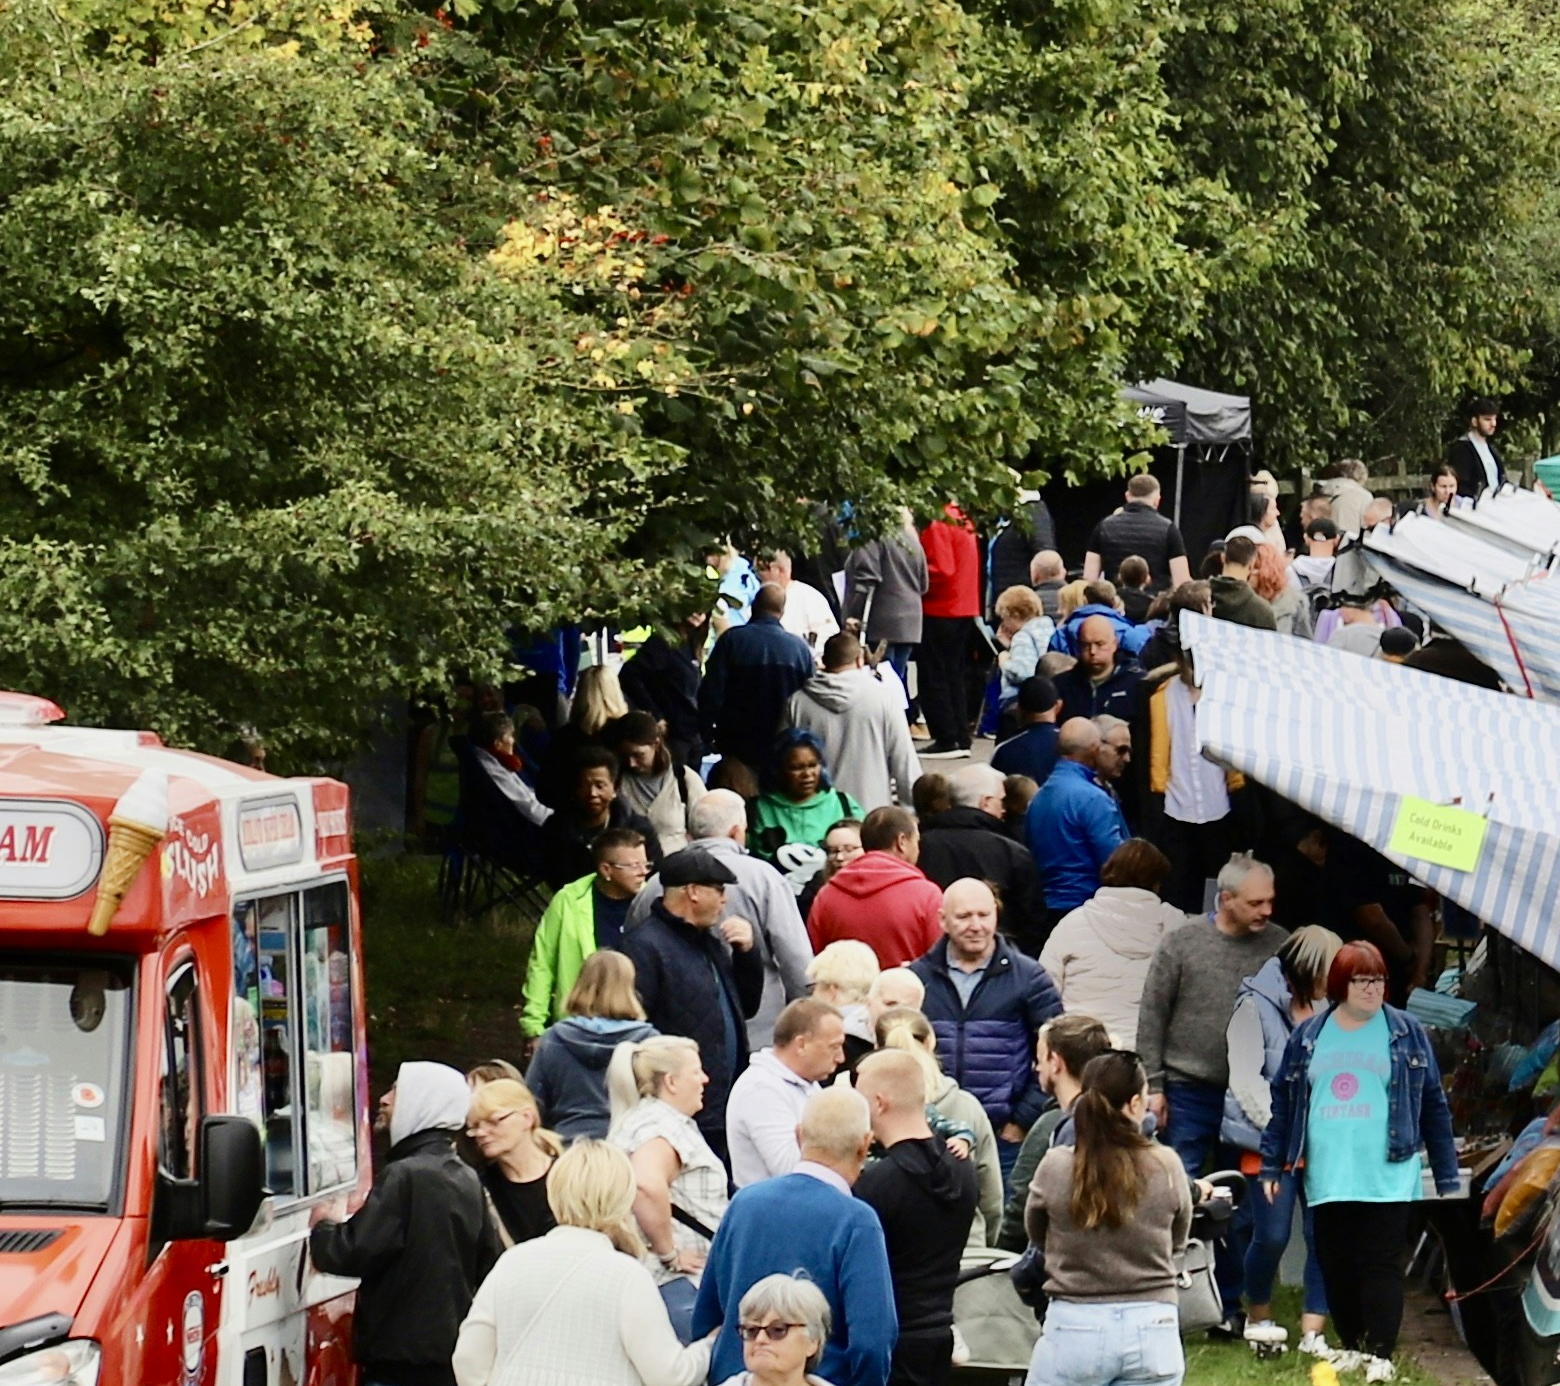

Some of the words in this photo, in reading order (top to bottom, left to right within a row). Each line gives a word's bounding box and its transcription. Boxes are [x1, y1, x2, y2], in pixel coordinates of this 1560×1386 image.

[1409, 812, 1431, 829] Cold
[1432, 819, 1462, 836] Drinks
[0, 825, 55, 862] AM
[1409, 831, 1453, 852] Available
[163, 841, 219, 899] SLUSH
